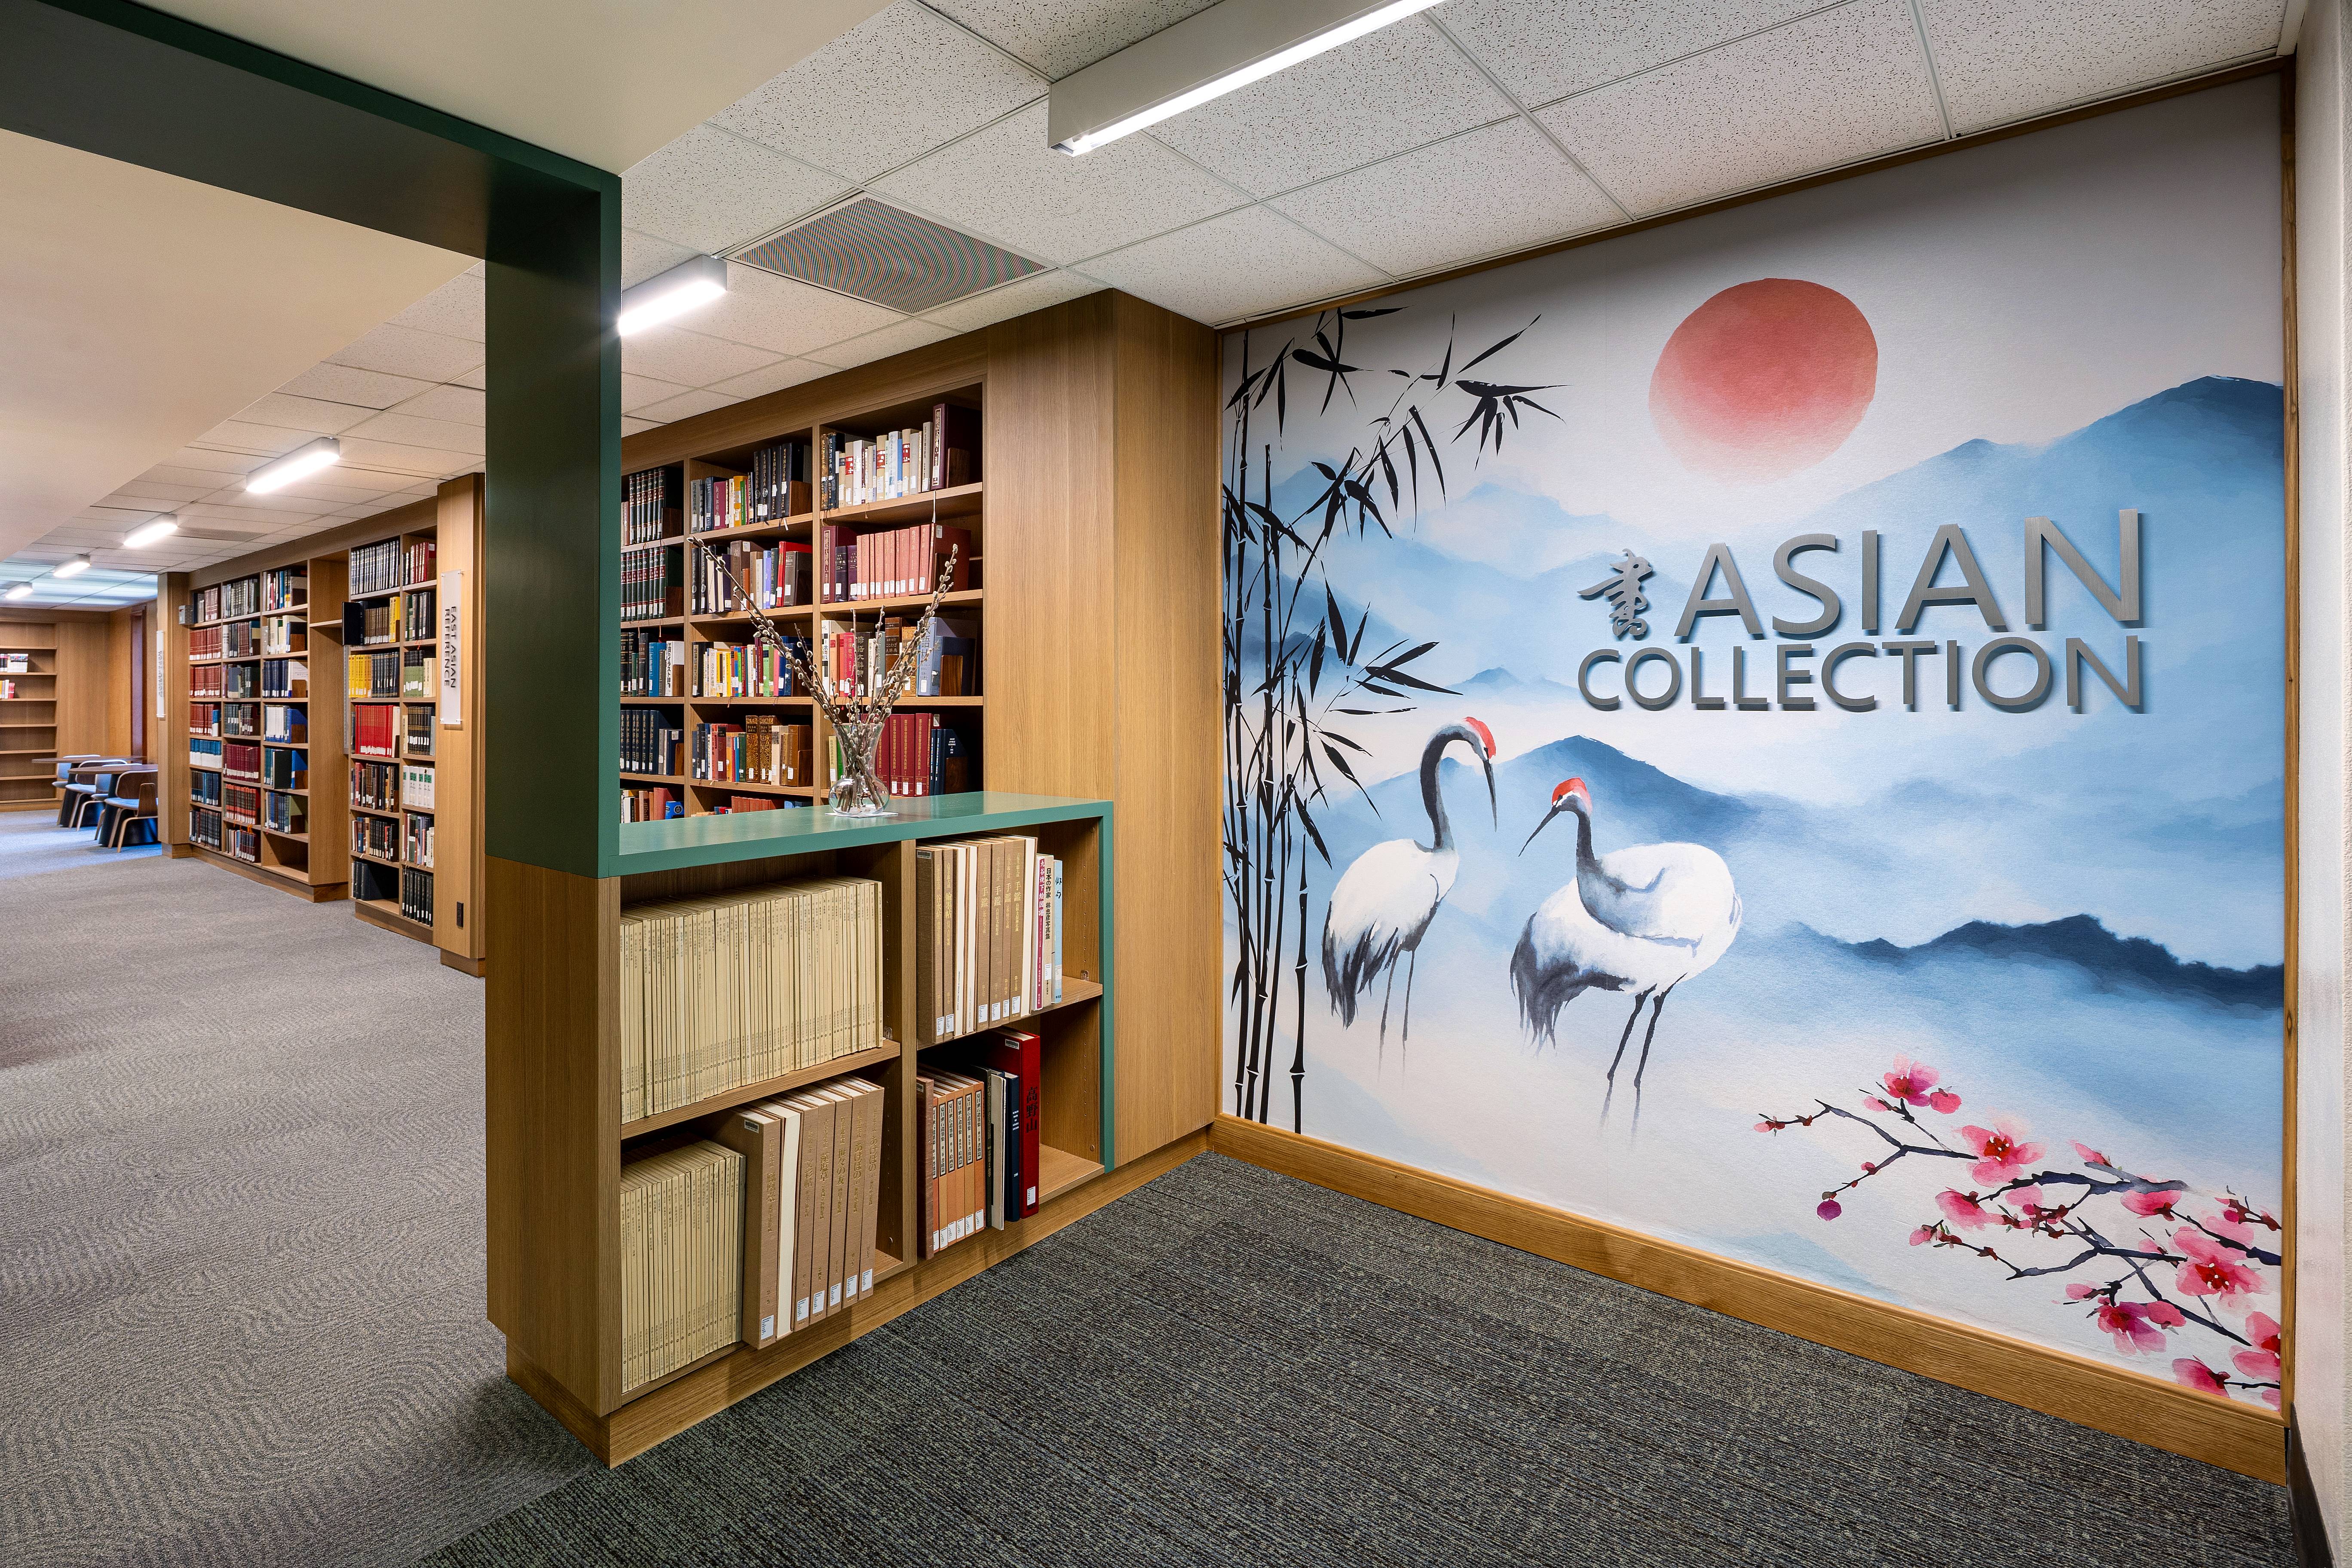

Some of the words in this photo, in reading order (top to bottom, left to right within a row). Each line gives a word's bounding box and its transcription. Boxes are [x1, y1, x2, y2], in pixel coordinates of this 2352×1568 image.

[1675, 508, 2140, 636] ASIAN
[1578, 635, 2140, 710] COLLECTION
[981, 886, 989, 907] 手鑑
[994, 885, 1001, 906] 手鑑
[1005, 883, 1011, 903] 手鑑
[1014, 881, 1021, 902] 手鑑
[1026, 1087, 1038, 1133] 高野山
[854, 1142, 863, 1180] あけぼの
[869, 1136, 878, 1172] あけぼの
